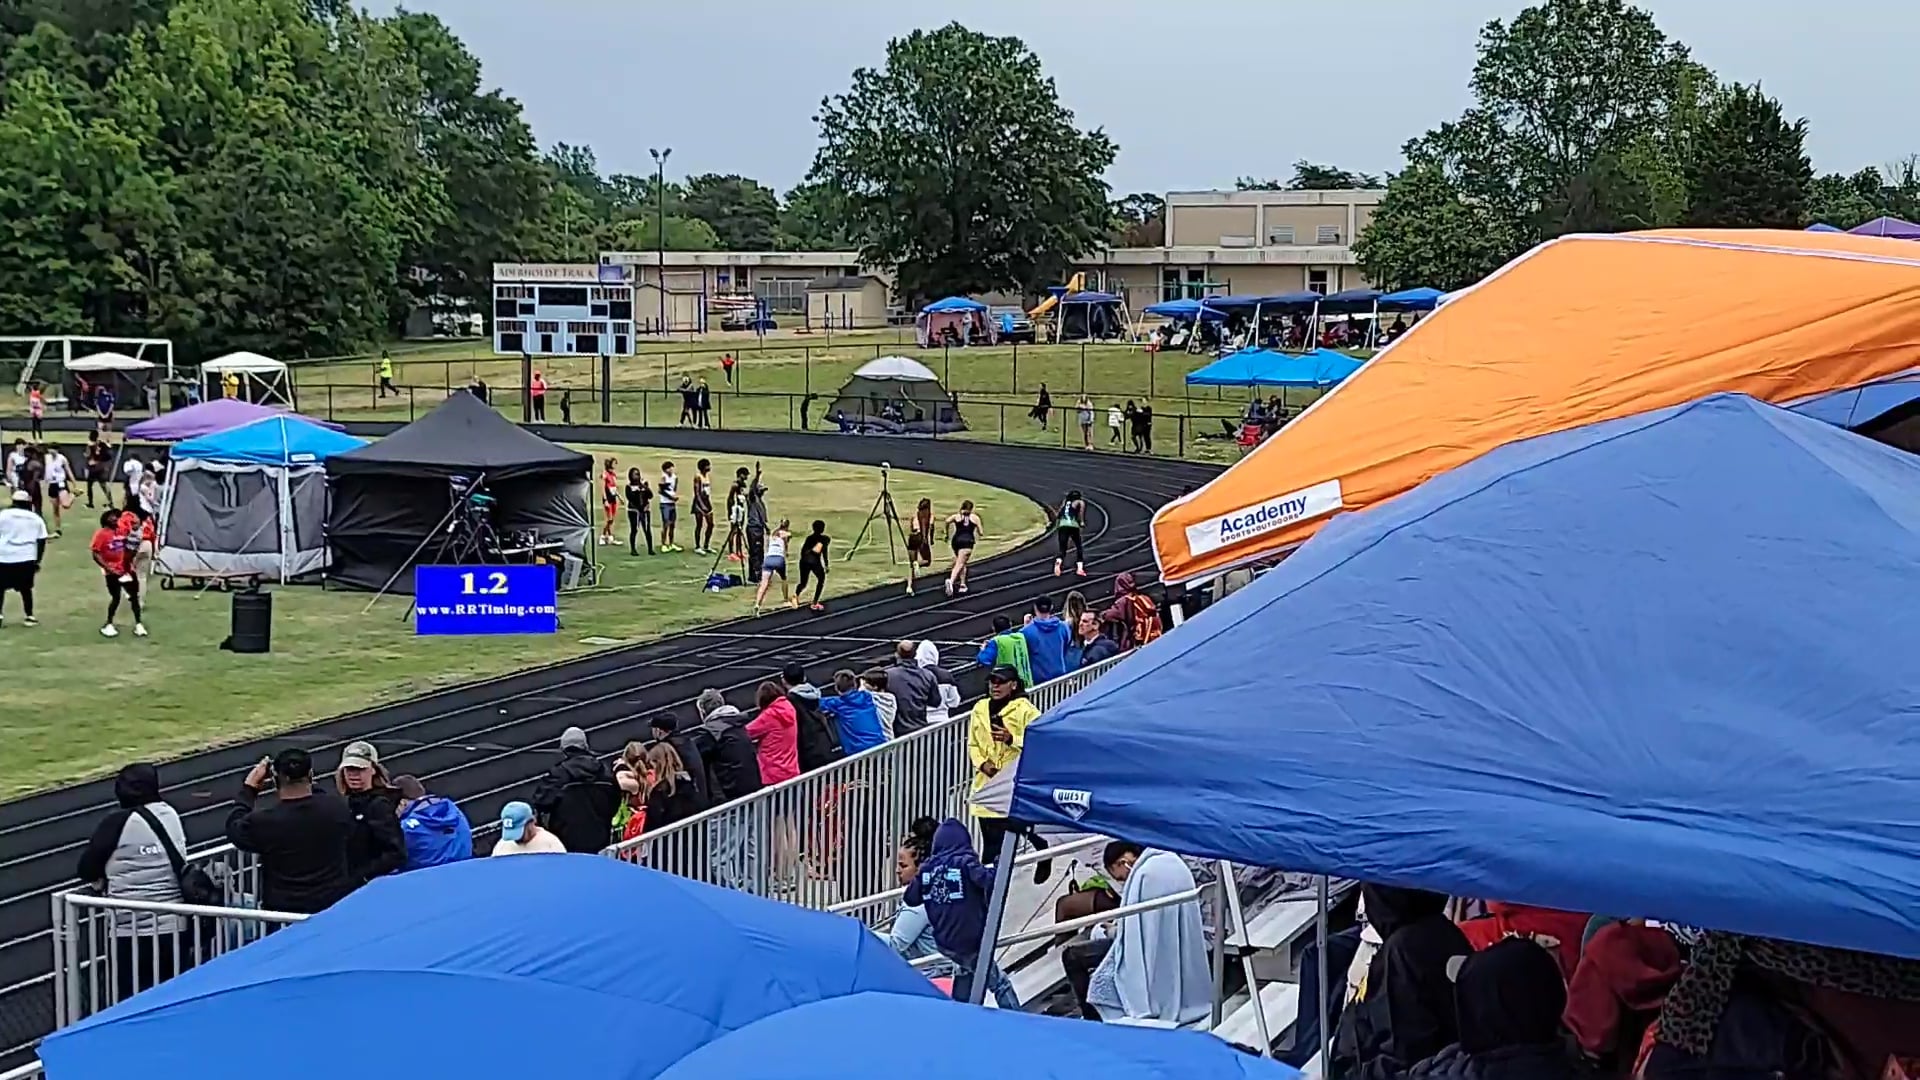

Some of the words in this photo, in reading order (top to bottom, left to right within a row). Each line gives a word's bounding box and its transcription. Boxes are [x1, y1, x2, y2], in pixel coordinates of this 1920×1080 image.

[562, 267, 595, 279] TRACK
[1220, 495, 1307, 536] Academy
[459, 572, 509, 594] 1.2
[416, 604, 555, 617] www.RRTiming.com
